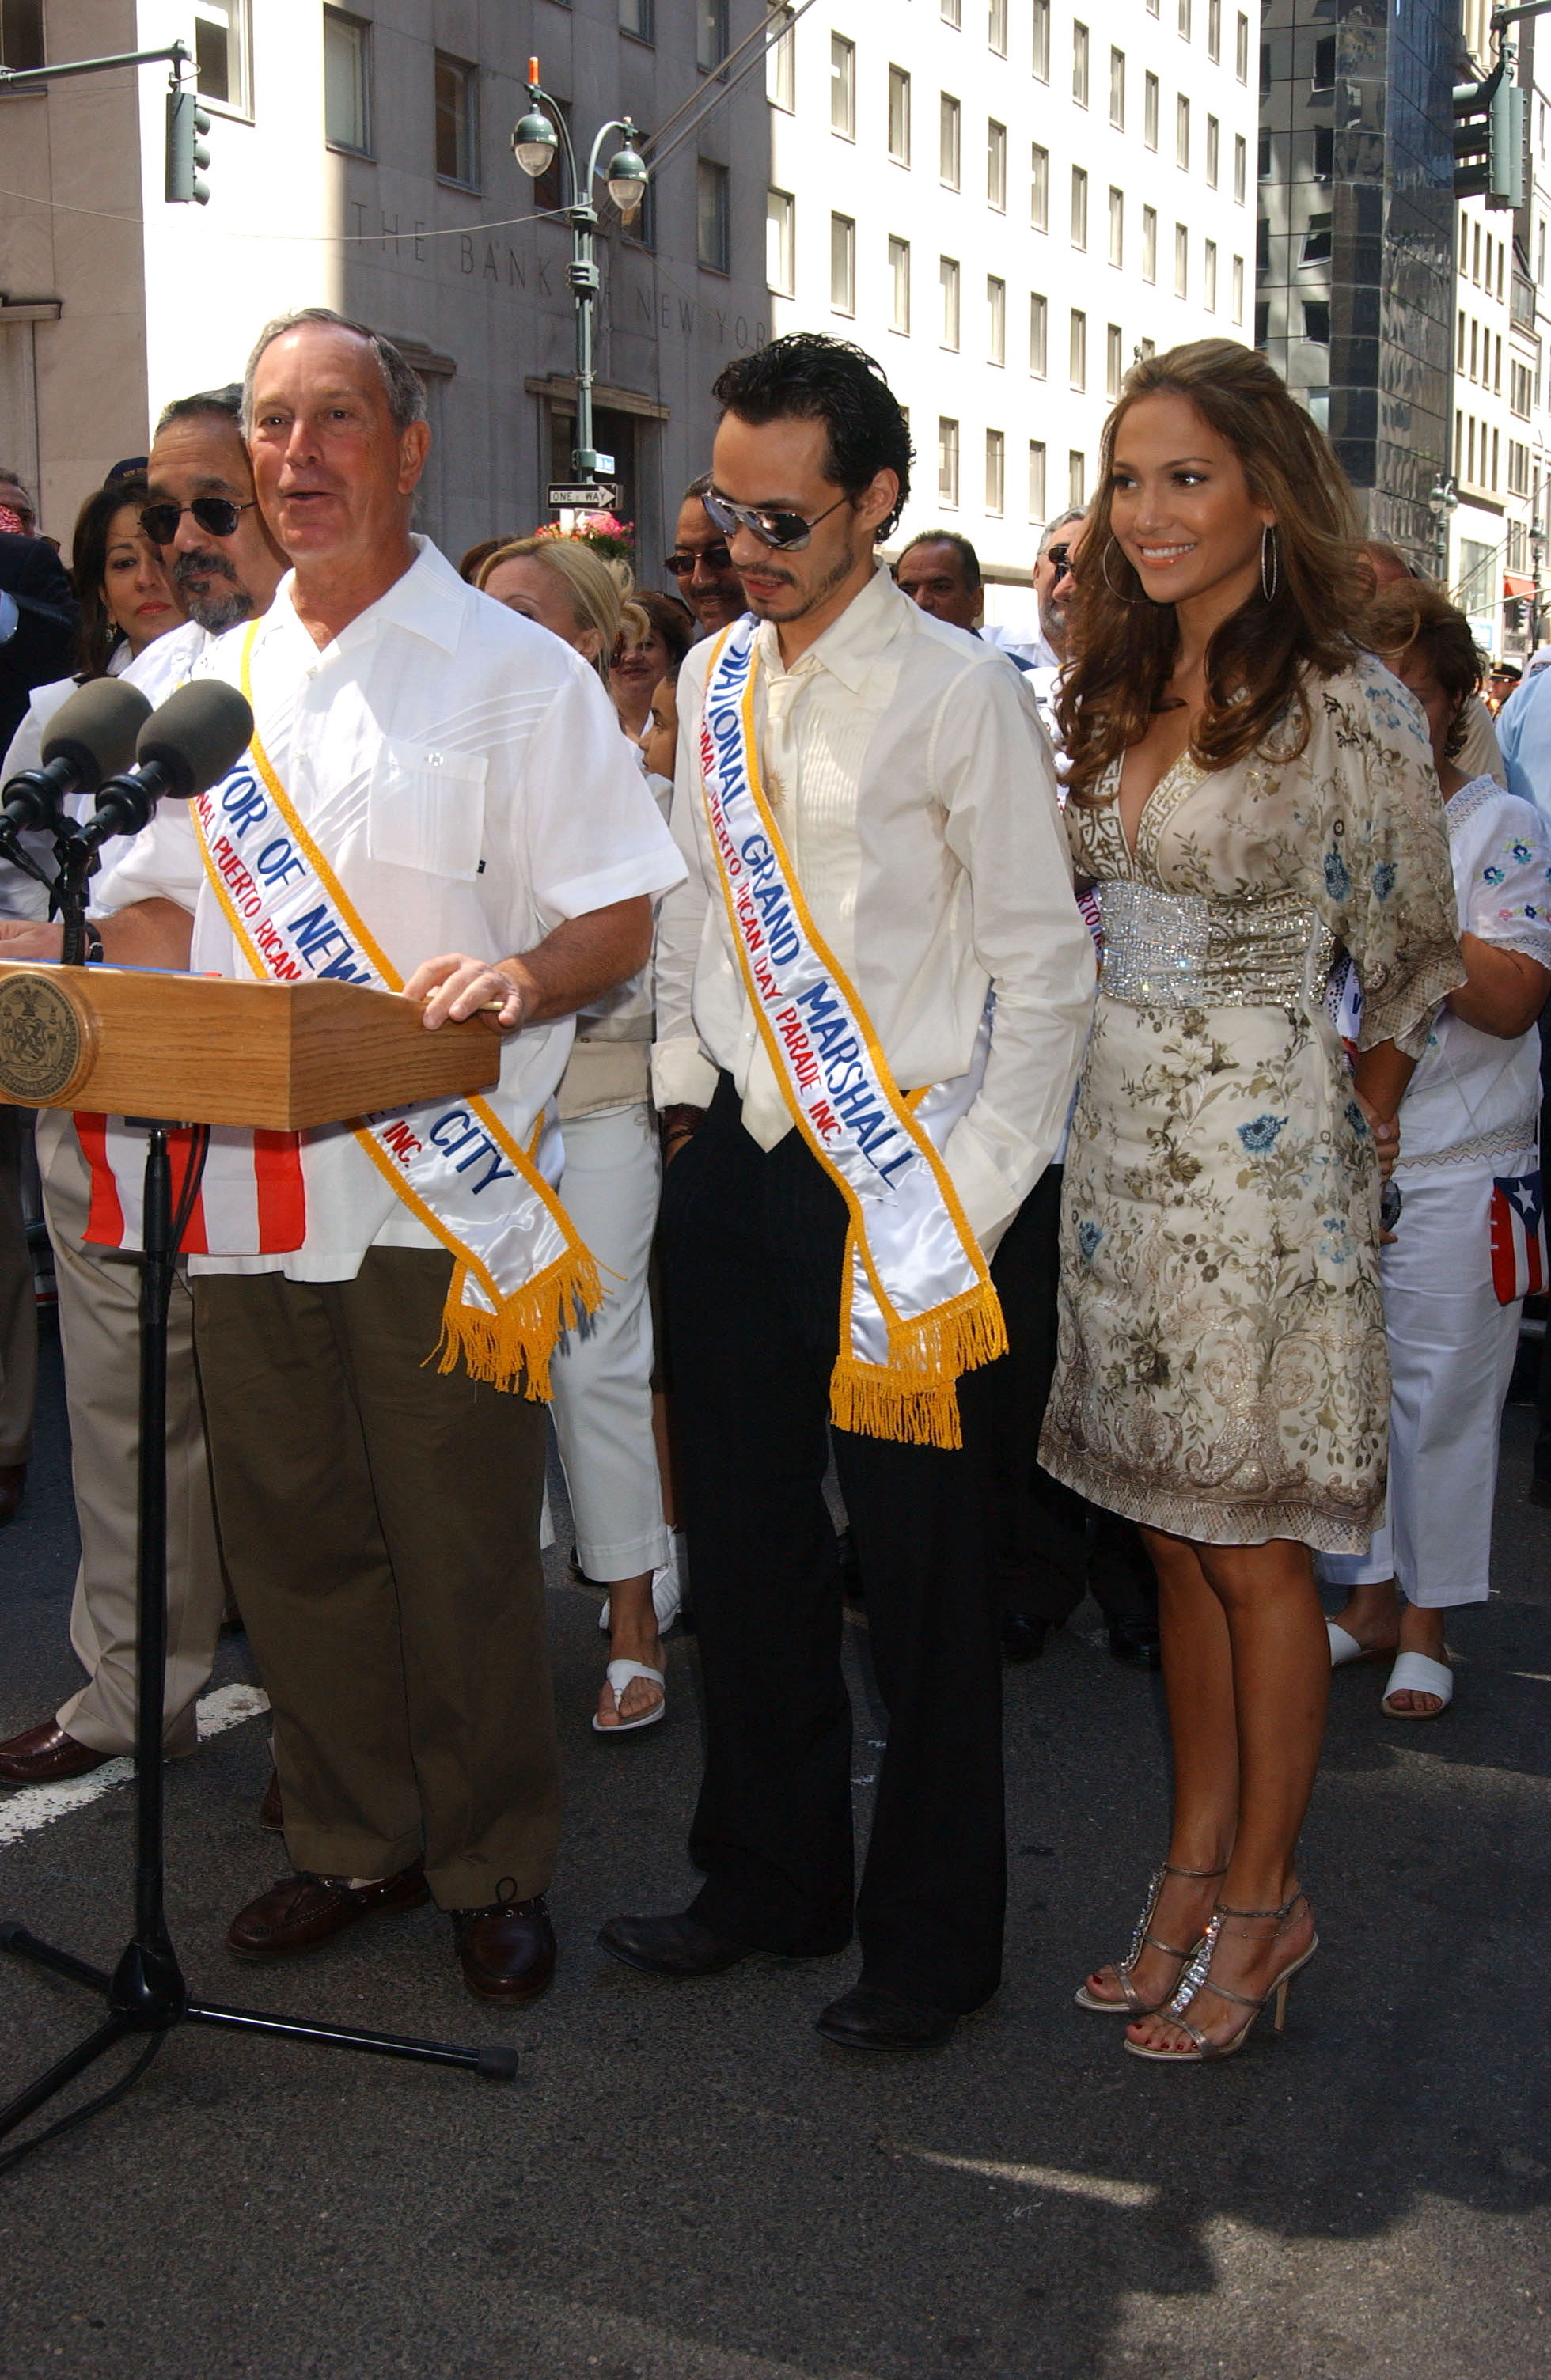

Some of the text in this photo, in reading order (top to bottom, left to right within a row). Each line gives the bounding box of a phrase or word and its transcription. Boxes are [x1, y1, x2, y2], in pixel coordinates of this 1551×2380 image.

[351, 201, 552, 297] THE BANK
[636, 286, 766, 351] NEW YOR
[552, 491, 606, 502] ONE WAY
[212, 836, 262, 918] PUERTO
[254, 917, 302, 980] RICAN
[214, 765, 372, 984] YOR OF NEW
[1076, 891, 1101, 926] RTO
[708, 790, 742, 876] PUERTO
[737, 882, 765, 953] RICAN
[753, 957, 783, 1001] DAY
[776, 1006, 821, 1096] PARADE
[808, 1099, 842, 1147] INC.
[741, 834, 800, 966] GRAND
[796, 980, 914, 1190] MARSHALL
[382, 1120, 422, 1168] INC.
[430, 1109, 514, 1195] CITY
